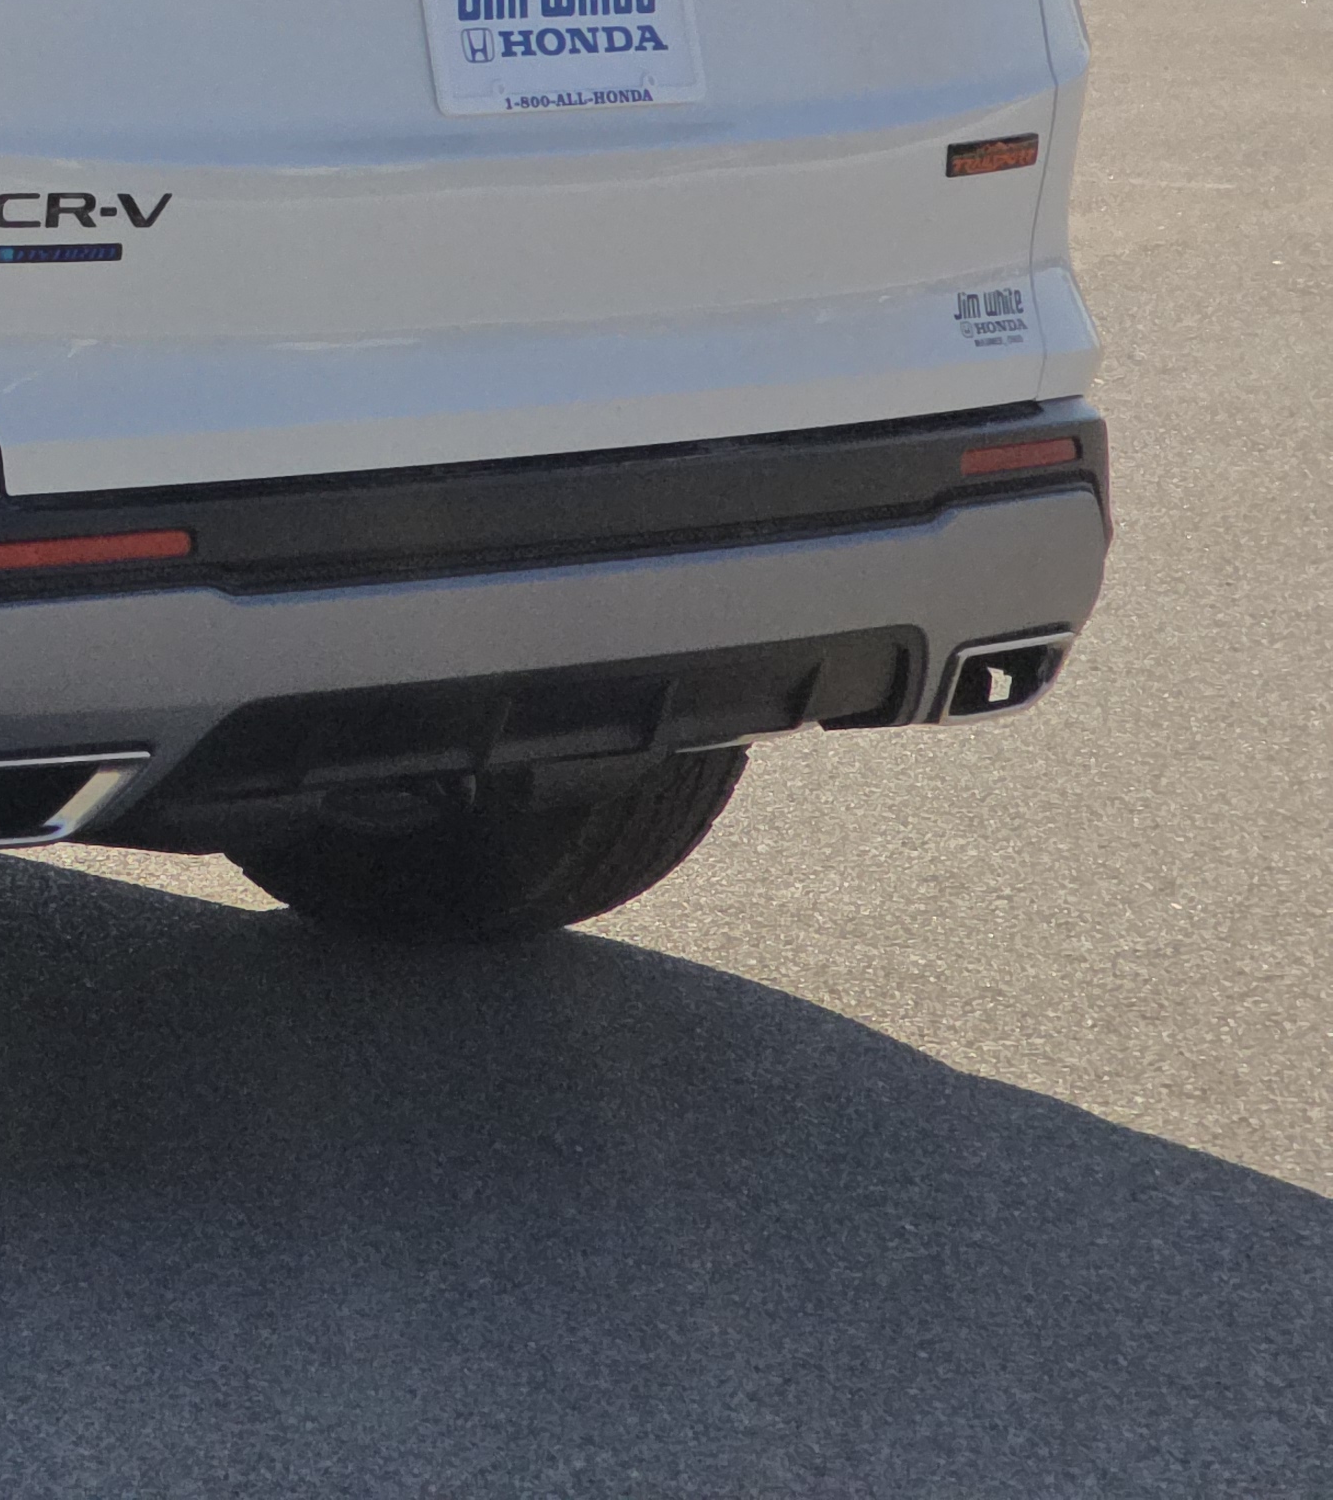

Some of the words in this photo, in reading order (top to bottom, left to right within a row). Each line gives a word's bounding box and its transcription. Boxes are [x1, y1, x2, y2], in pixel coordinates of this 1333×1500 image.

[498, 25, 669, 57] HONDA
[505, 88, 654, 110] 1-800-ALL-HONDA
[954, 291, 981, 320] Jim
[974, 318, 1029, 334] HONDA
